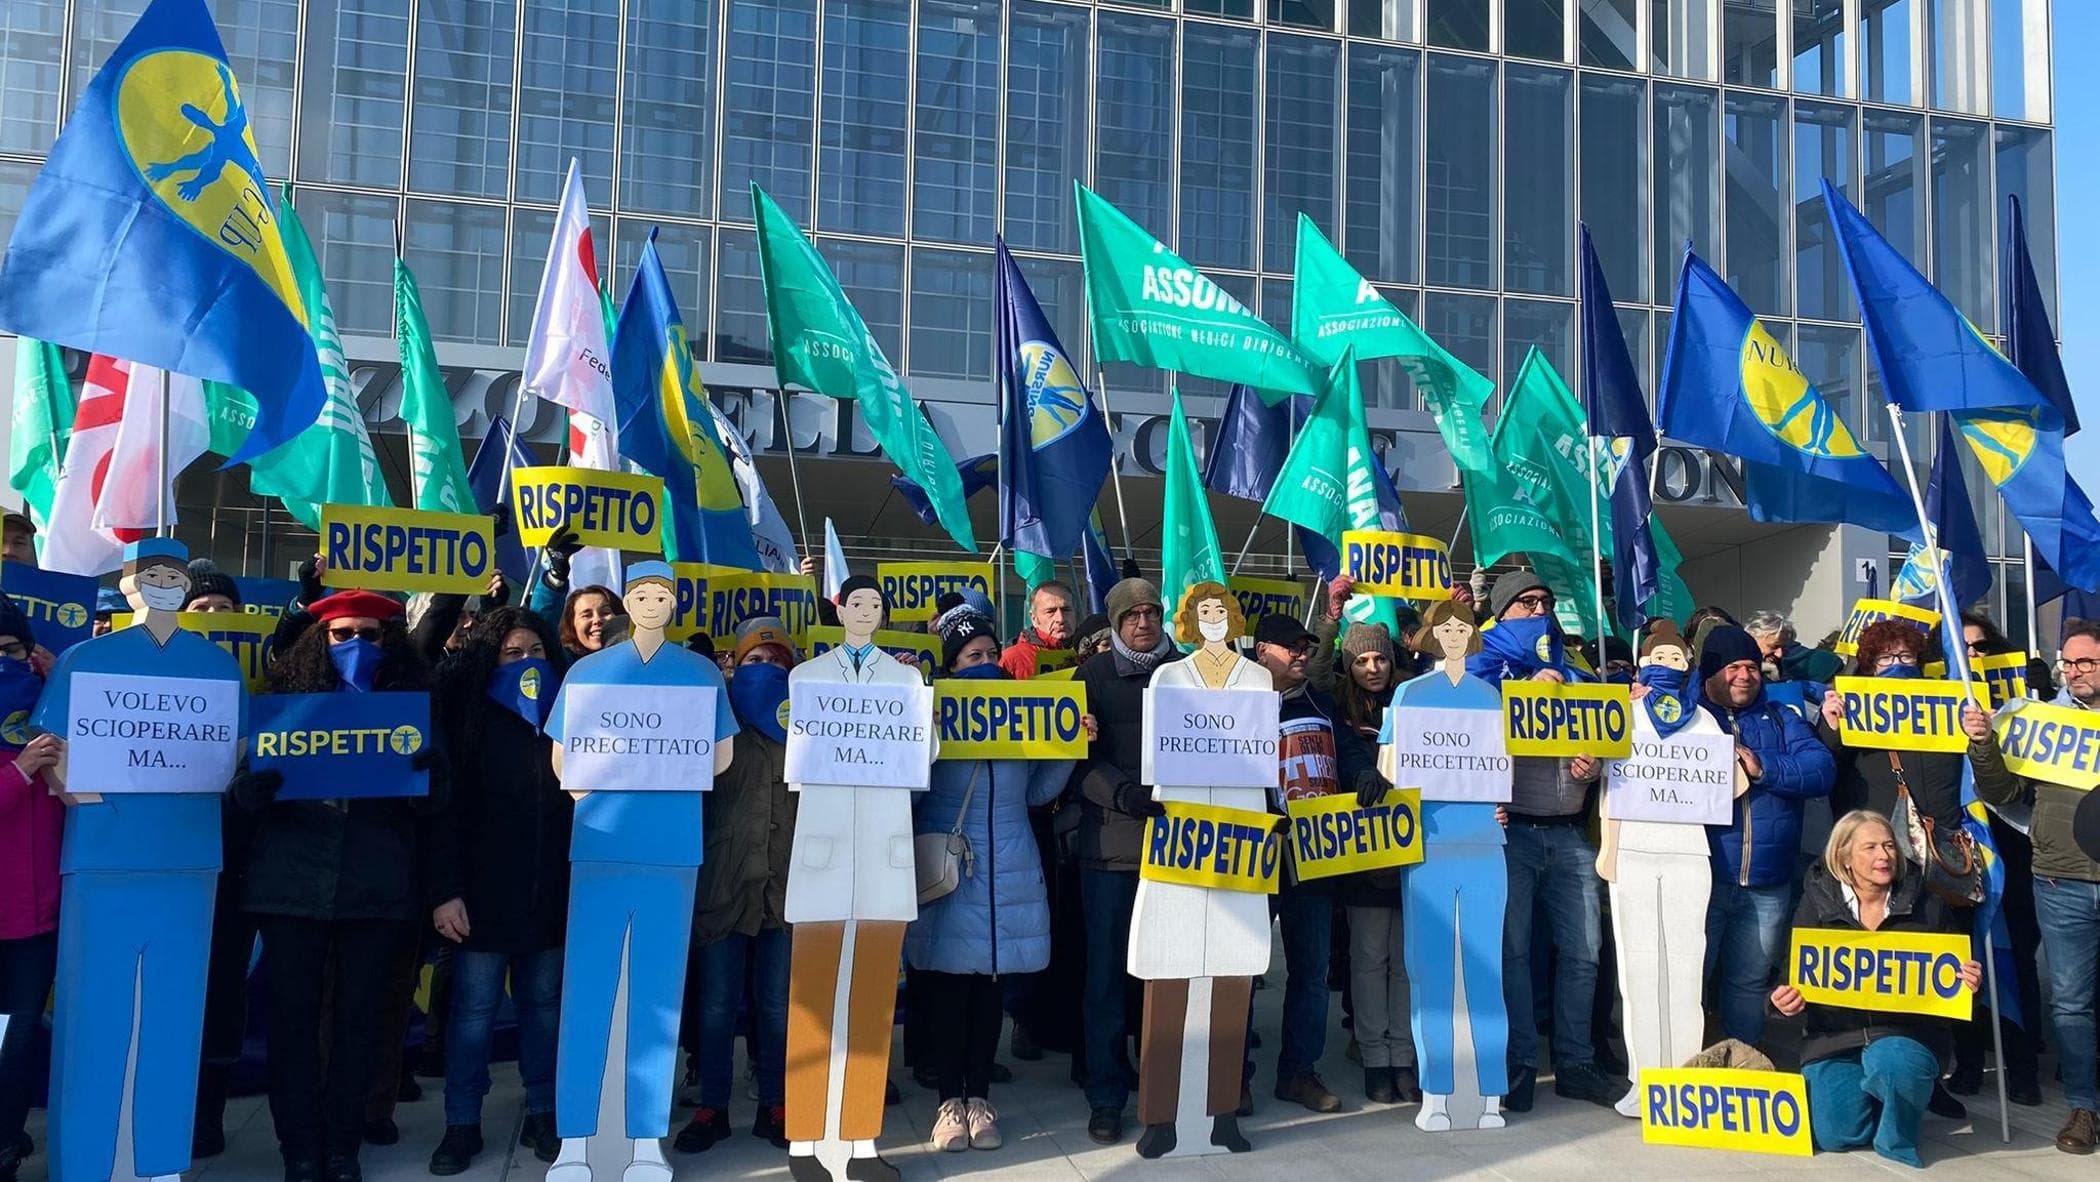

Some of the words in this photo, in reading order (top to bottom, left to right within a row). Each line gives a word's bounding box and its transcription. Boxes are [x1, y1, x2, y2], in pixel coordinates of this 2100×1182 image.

[518, 485, 656, 537] RISPETTO
[328, 521, 488, 578] RISPETTO
[1350, 539, 1452, 590] RISPETTO
[103, 690, 207, 714] VOLEVO
[817, 695, 904, 718] VOLEVO
[75, 717, 231, 743] SCIOPERARE
[600, 710, 662, 730] SONO
[792, 719, 925, 744] SCIOPERARE
[941, 697, 1079, 743] RISPETTO
[1183, 713, 1235, 731] SONO
[1509, 697, 1627, 743] RISPETTO
[569, 735, 710, 757] PRECETTATO
[1159, 736, 1276, 756] PRECETTATO
[1422, 730, 1471, 748] SONO
[127, 749, 187, 769] MA...
[834, 746, 885, 767] MA...
[1400, 752, 1509, 773] PRECETTATO
[1631, 742, 1708, 762] VOLEVO
[1612, 764, 1728, 787] SCIOPERARE
[1650, 788, 1694, 806] MA...
[1296, 802, 1417, 862] RISPETTO
[1148, 813, 1278, 882] RISPETTO
[1797, 944, 1963, 999] RISPETTO
[1648, 1083, 1800, 1137] RISPETTO
